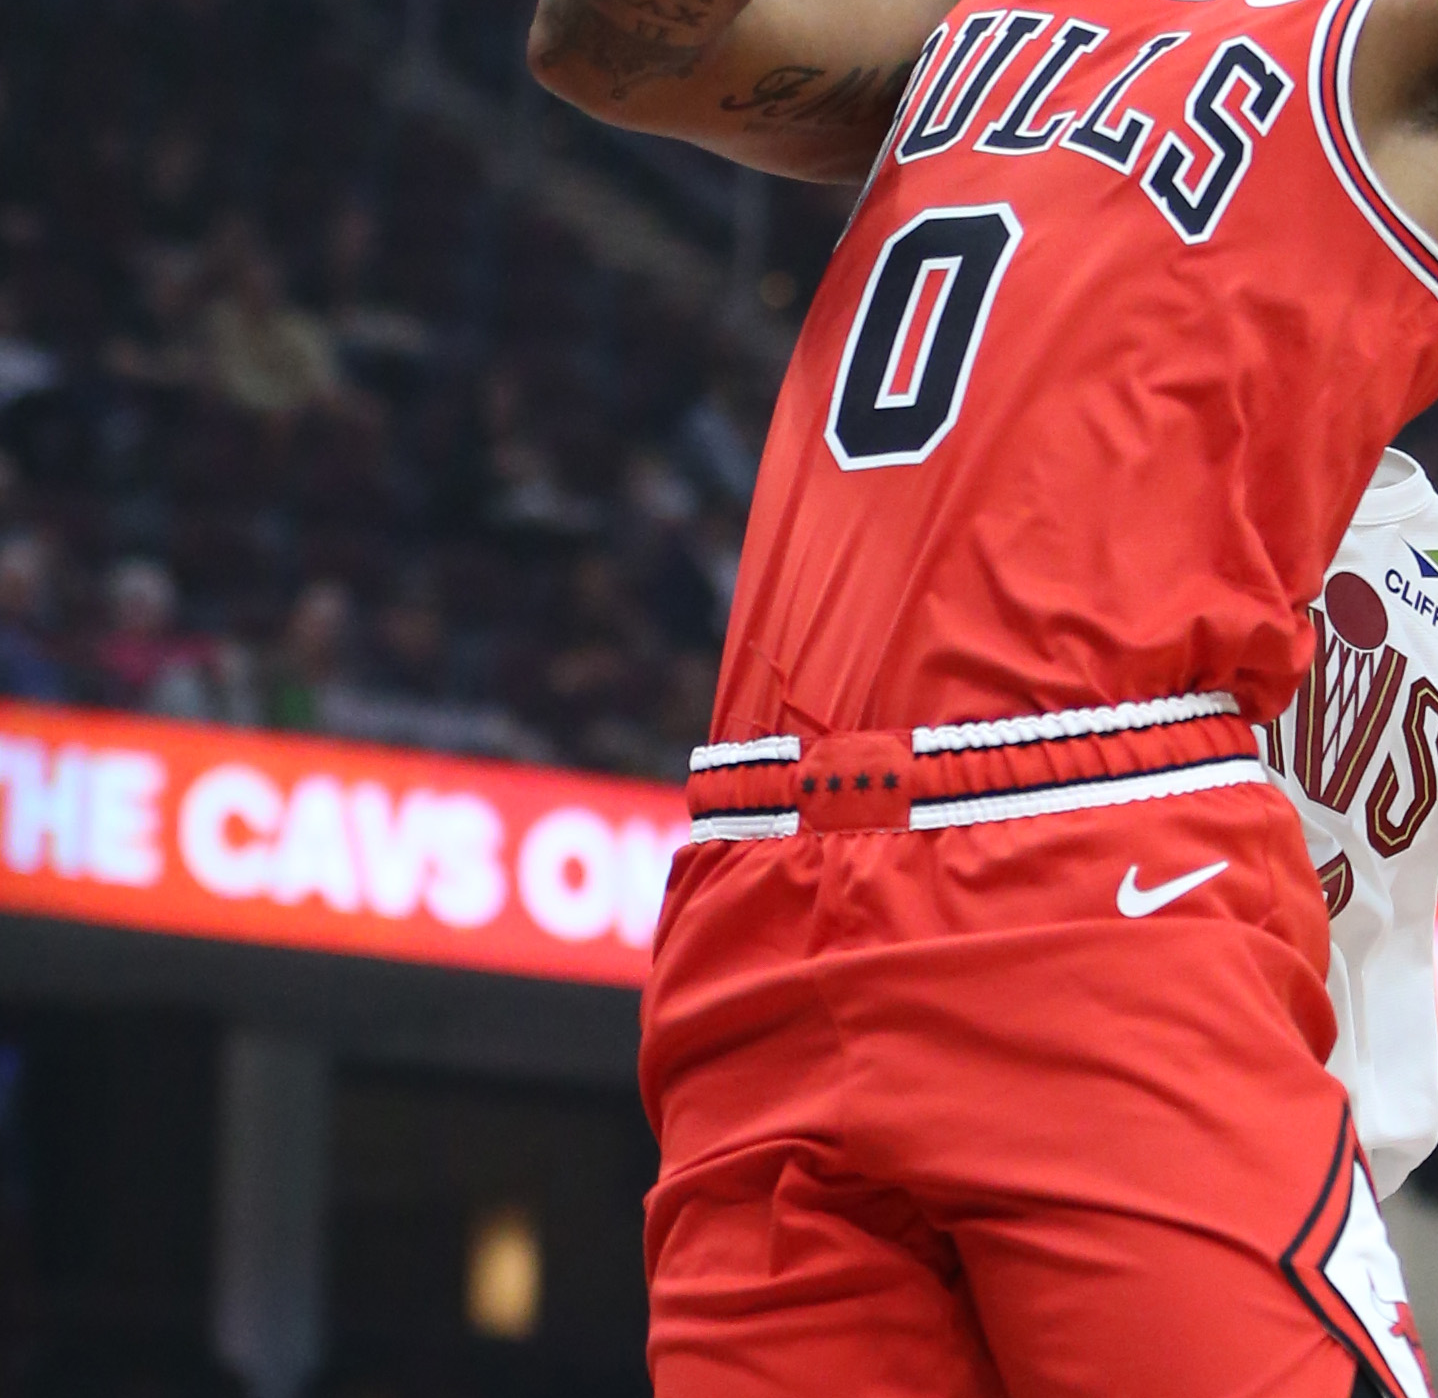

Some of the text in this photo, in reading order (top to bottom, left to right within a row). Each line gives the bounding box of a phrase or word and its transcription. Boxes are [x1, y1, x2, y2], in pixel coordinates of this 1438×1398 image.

[890, 10, 1295, 245] ULLS
[824, 202, 1023, 472] 0
[177, 762, 505, 929] CAVS
